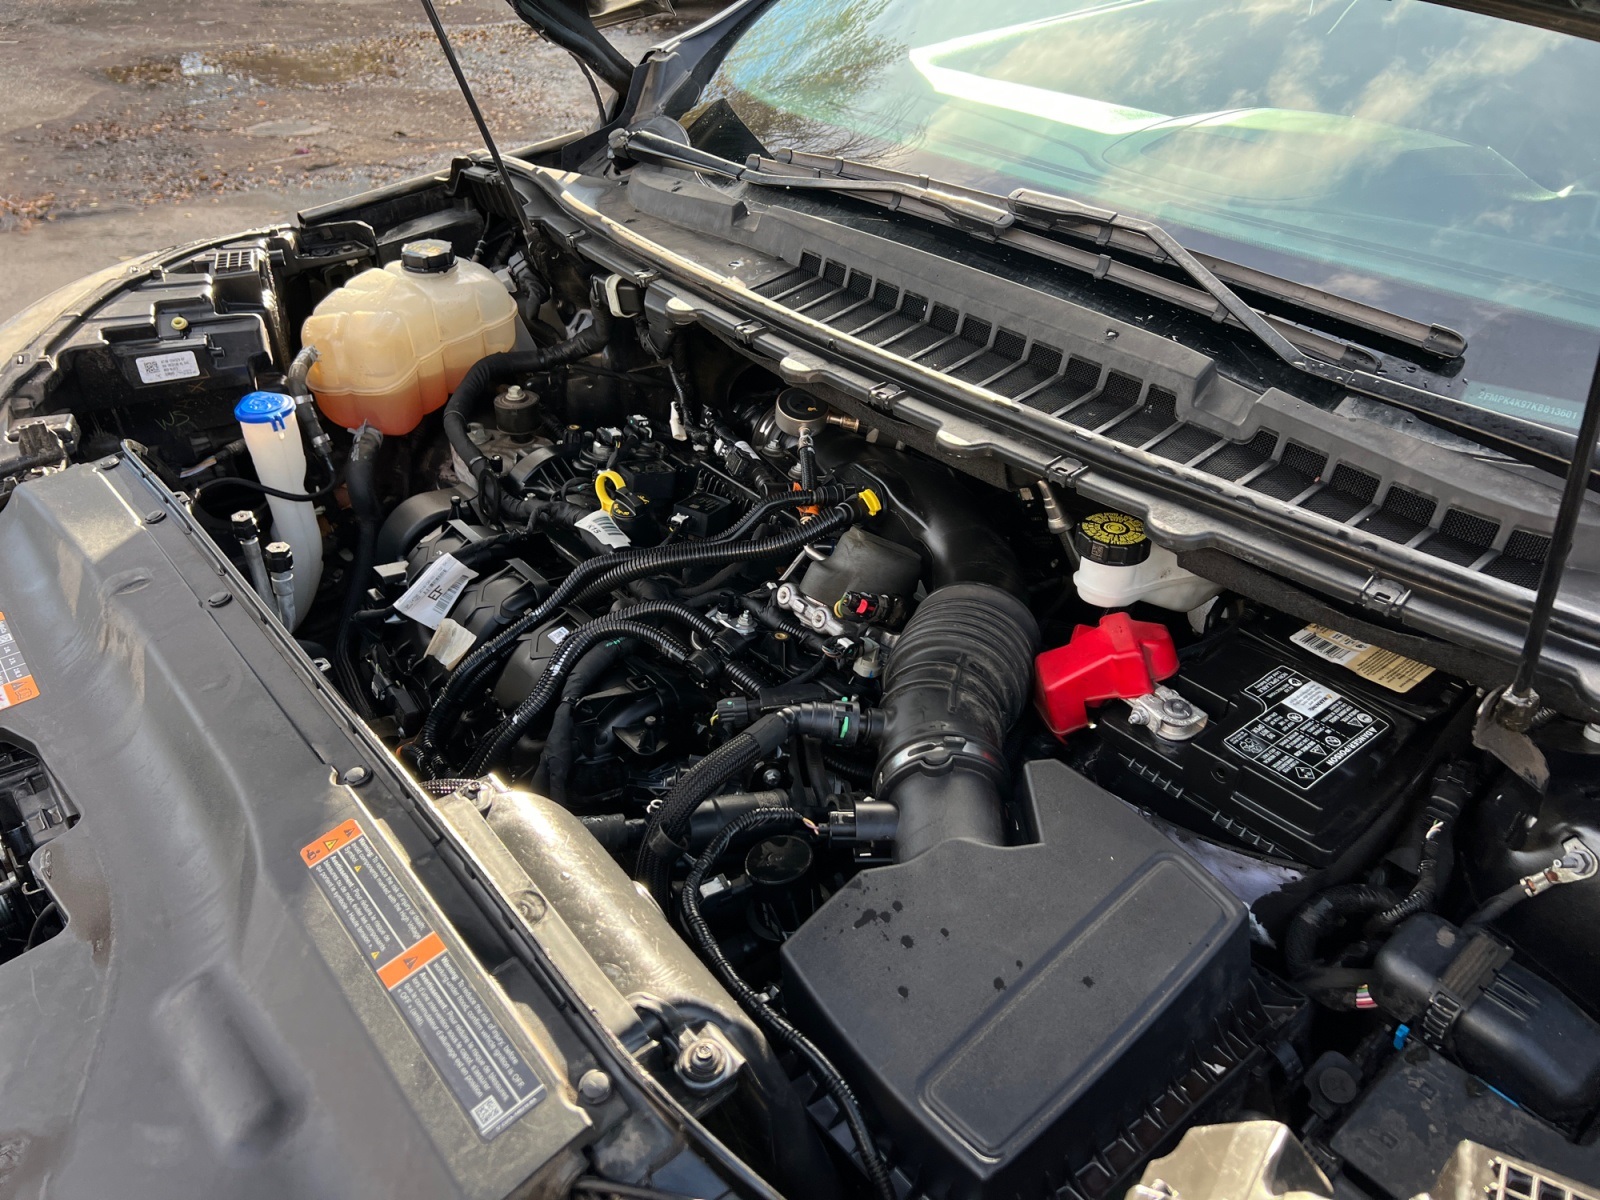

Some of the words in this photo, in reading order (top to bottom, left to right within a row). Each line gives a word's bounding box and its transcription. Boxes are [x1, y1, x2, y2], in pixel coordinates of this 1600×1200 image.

[1478, 391, 1578, 420] 2FMPK4K97KBB13601
[427, 585, 443, 600] EF
[1325, 730, 1373, 765] DANGER/POISON
[398, 990, 412, 1005] OFF
